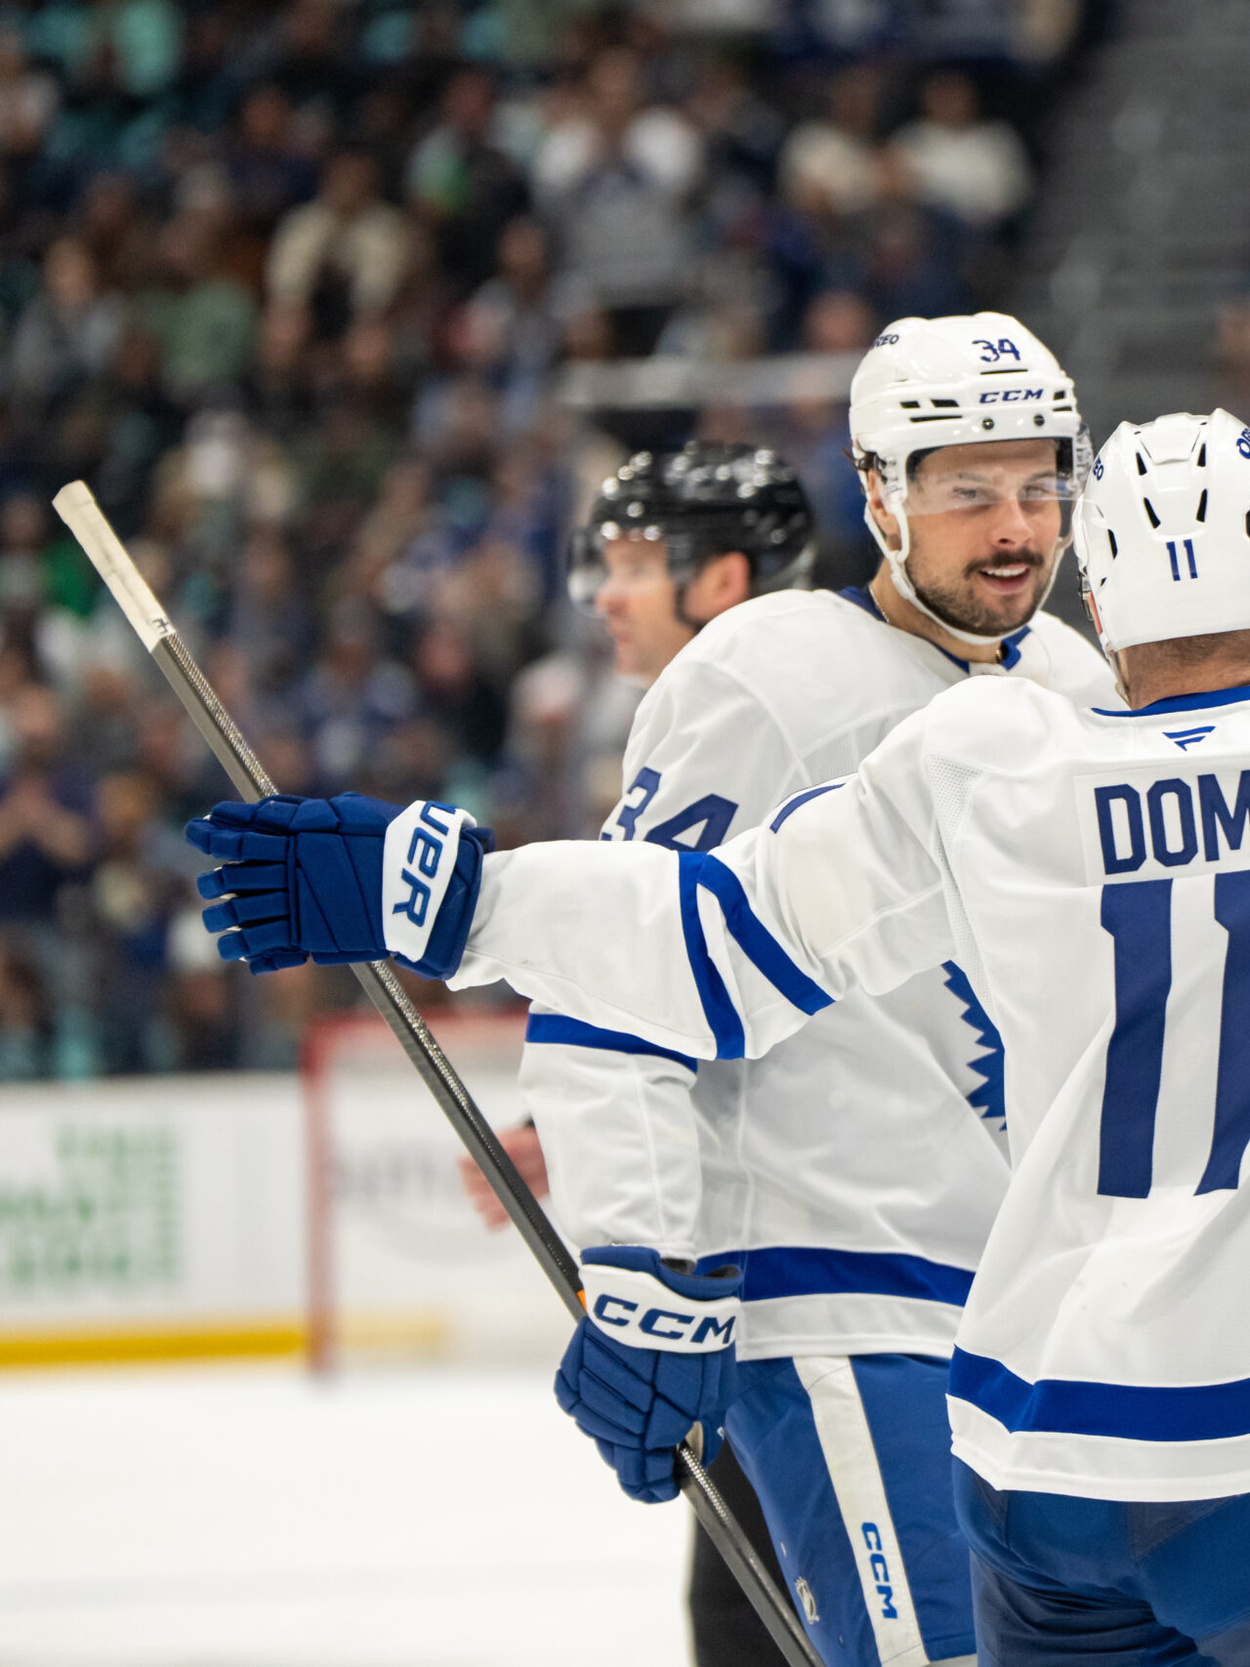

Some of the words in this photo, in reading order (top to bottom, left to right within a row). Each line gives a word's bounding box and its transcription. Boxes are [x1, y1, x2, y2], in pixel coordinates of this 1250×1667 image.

[972, 339, 1021, 362] 34
[979, 389, 1043, 404] CCM
[1166, 539, 1198, 581] 11
[600, 766, 739, 852] 34
[392, 800, 459, 928] UER
[593, 1293, 736, 1345] CCM
[861, 1521, 898, 1619] CCM
